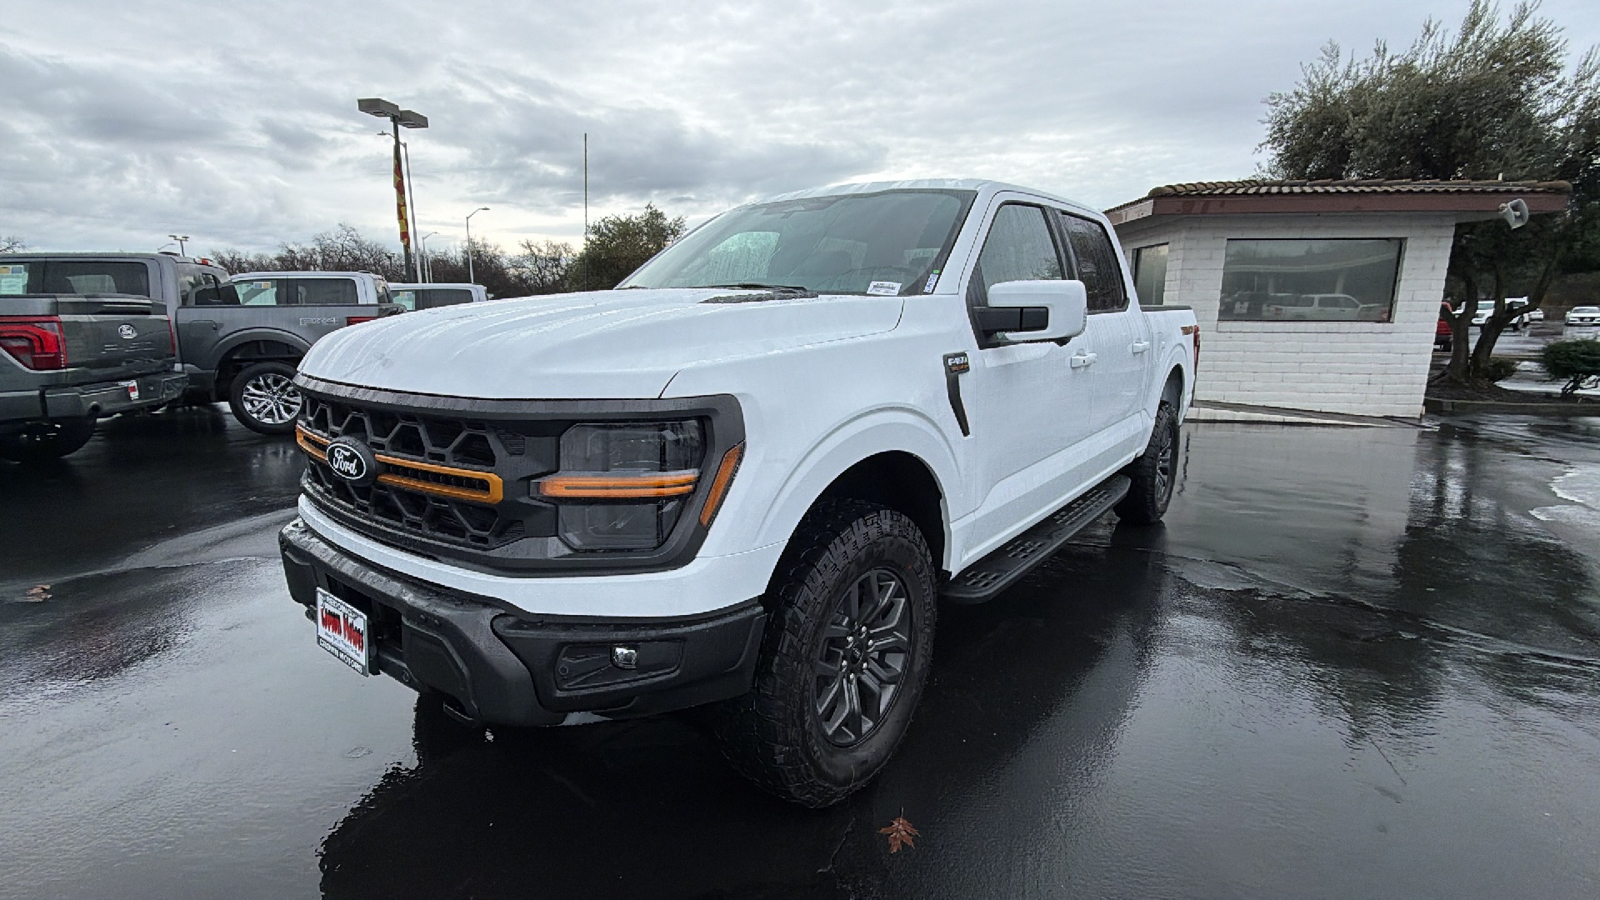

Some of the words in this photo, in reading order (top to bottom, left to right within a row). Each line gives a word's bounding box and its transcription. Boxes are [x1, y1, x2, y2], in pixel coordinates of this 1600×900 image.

[333, 448, 357, 475] Ford
[320, 639, 339, 657] CROWN
[339, 651, 363, 673] MOTORS
